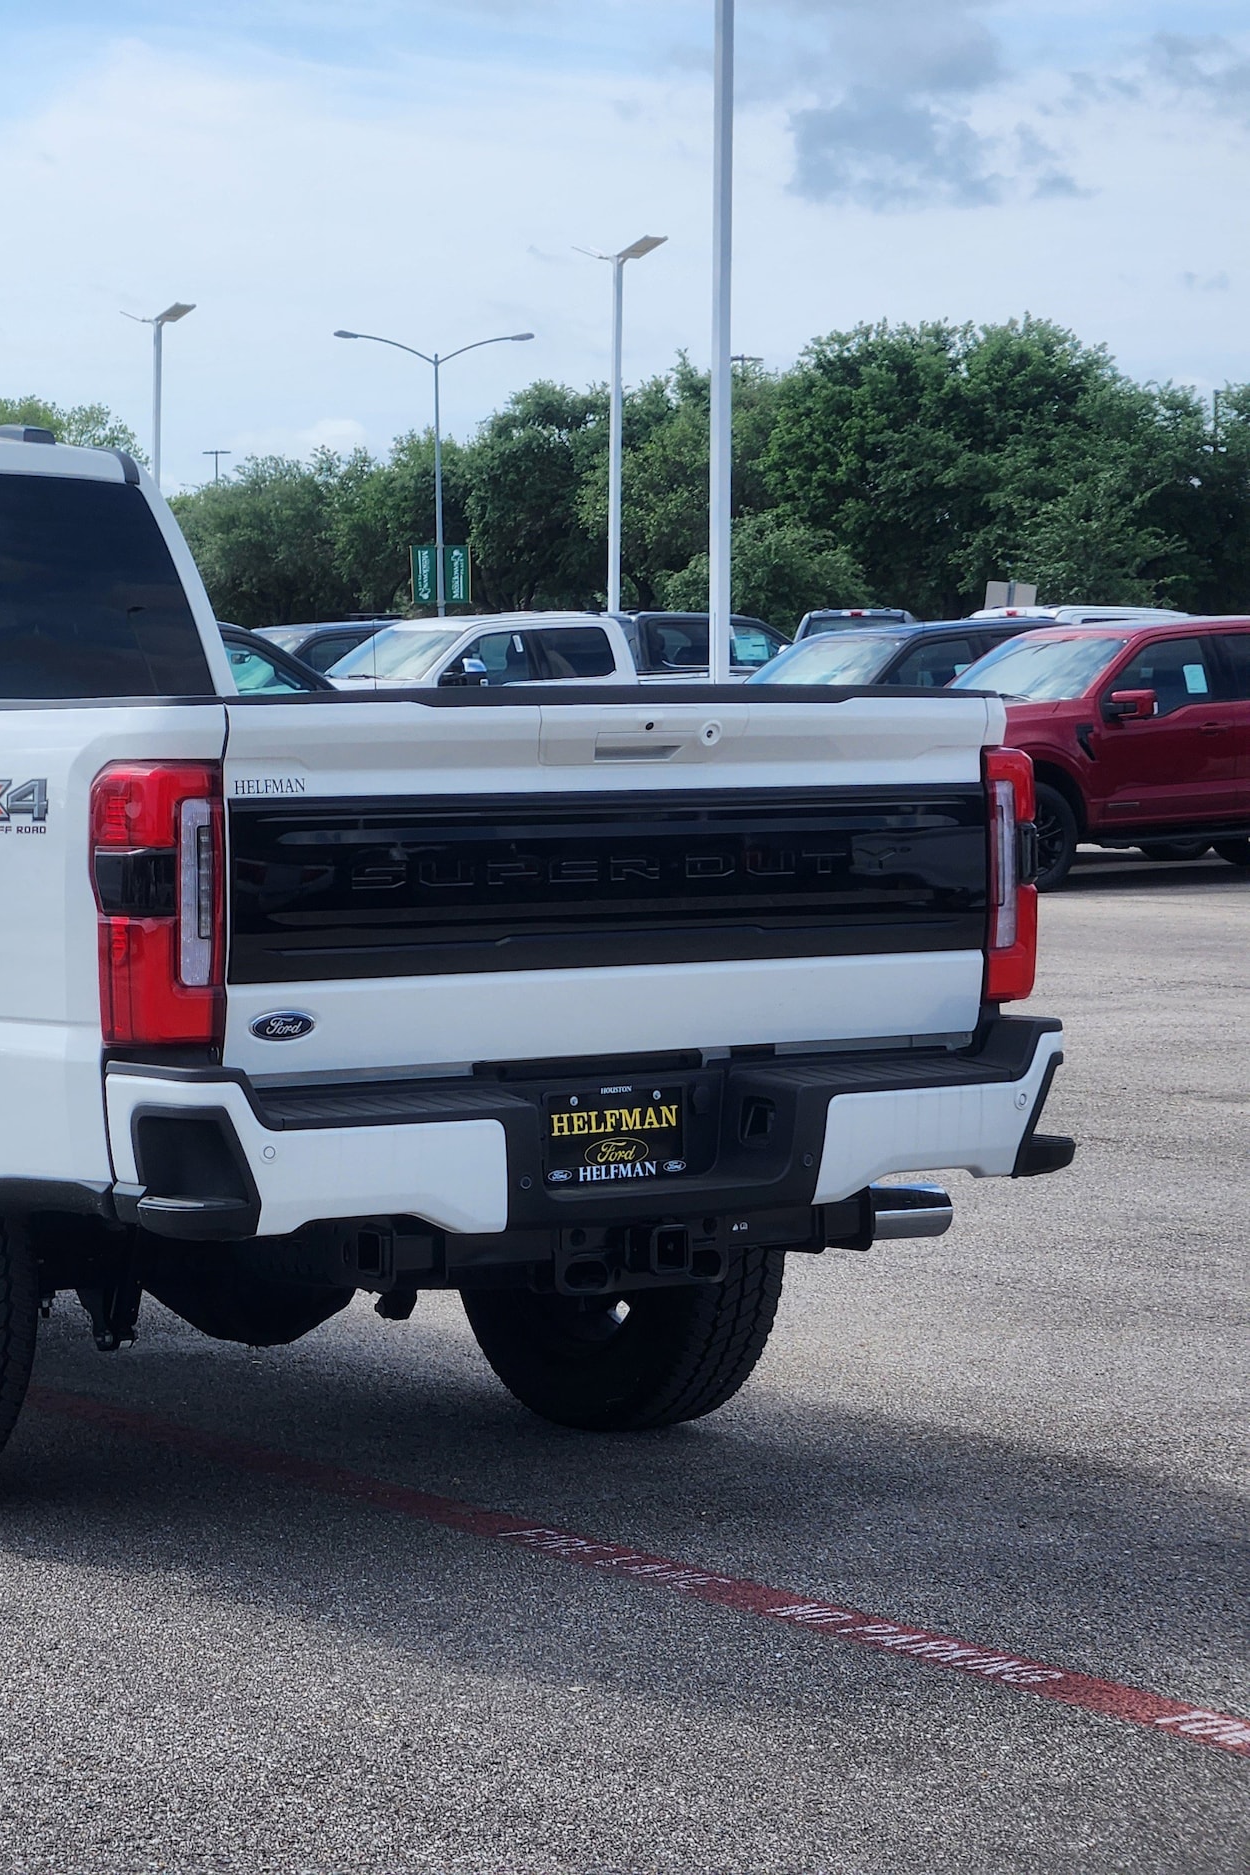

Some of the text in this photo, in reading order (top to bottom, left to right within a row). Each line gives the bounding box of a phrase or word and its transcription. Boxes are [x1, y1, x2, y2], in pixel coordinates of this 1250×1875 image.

[234, 778, 305, 795] HELFMAN
[16, 825, 47, 835] ROAD
[350, 846, 899, 891] SUPER DUTY
[265, 1016, 303, 1036] Ford
[600, 1085, 633, 1095] HOUSTON
[550, 1105, 679, 1137] HELFMAN
[596, 1140, 637, 1164] Ford
[578, 1160, 657, 1182] HELFMAN
